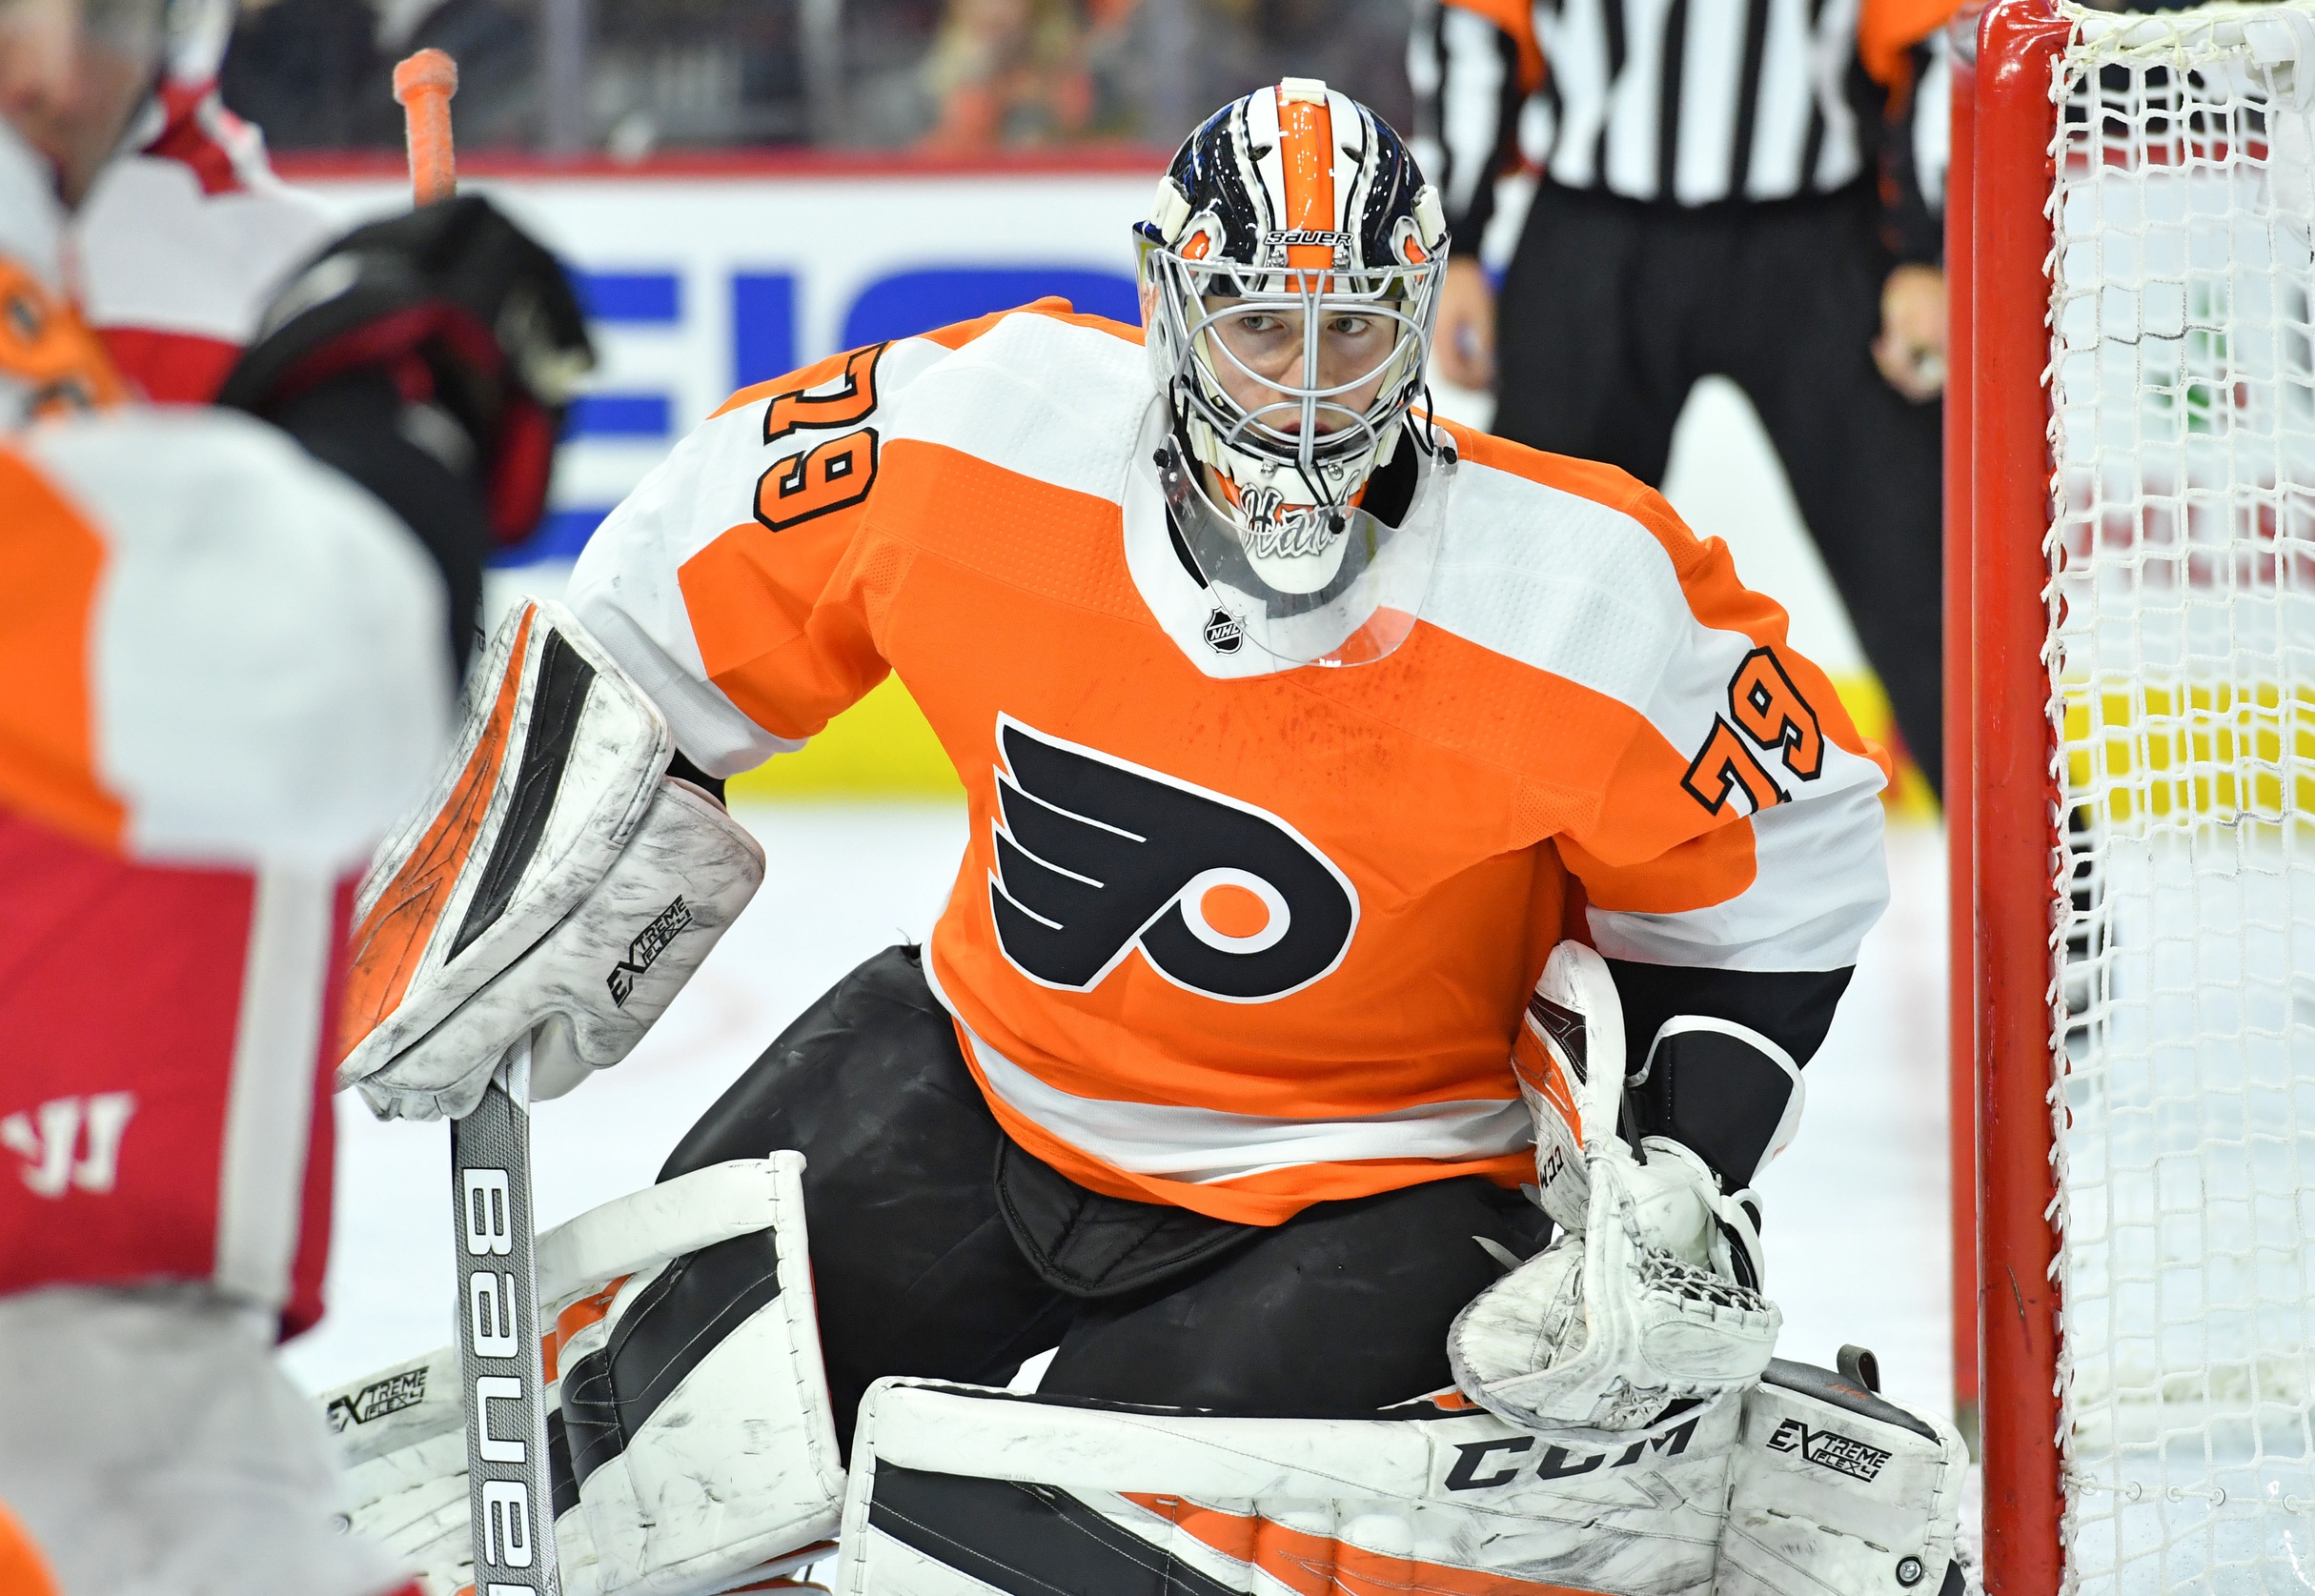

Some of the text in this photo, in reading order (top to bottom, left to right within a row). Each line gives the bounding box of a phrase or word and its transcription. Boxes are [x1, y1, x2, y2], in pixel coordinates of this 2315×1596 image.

[754, 340, 879, 533] 79
[1210, 623, 1240, 640] NHL
[1680, 646, 1824, 817] 79
[606, 894, 686, 1008] EXTREME
[327, 1365, 429, 1432] EXTREME
[1766, 1418, 1893, 1469] EXTREME
